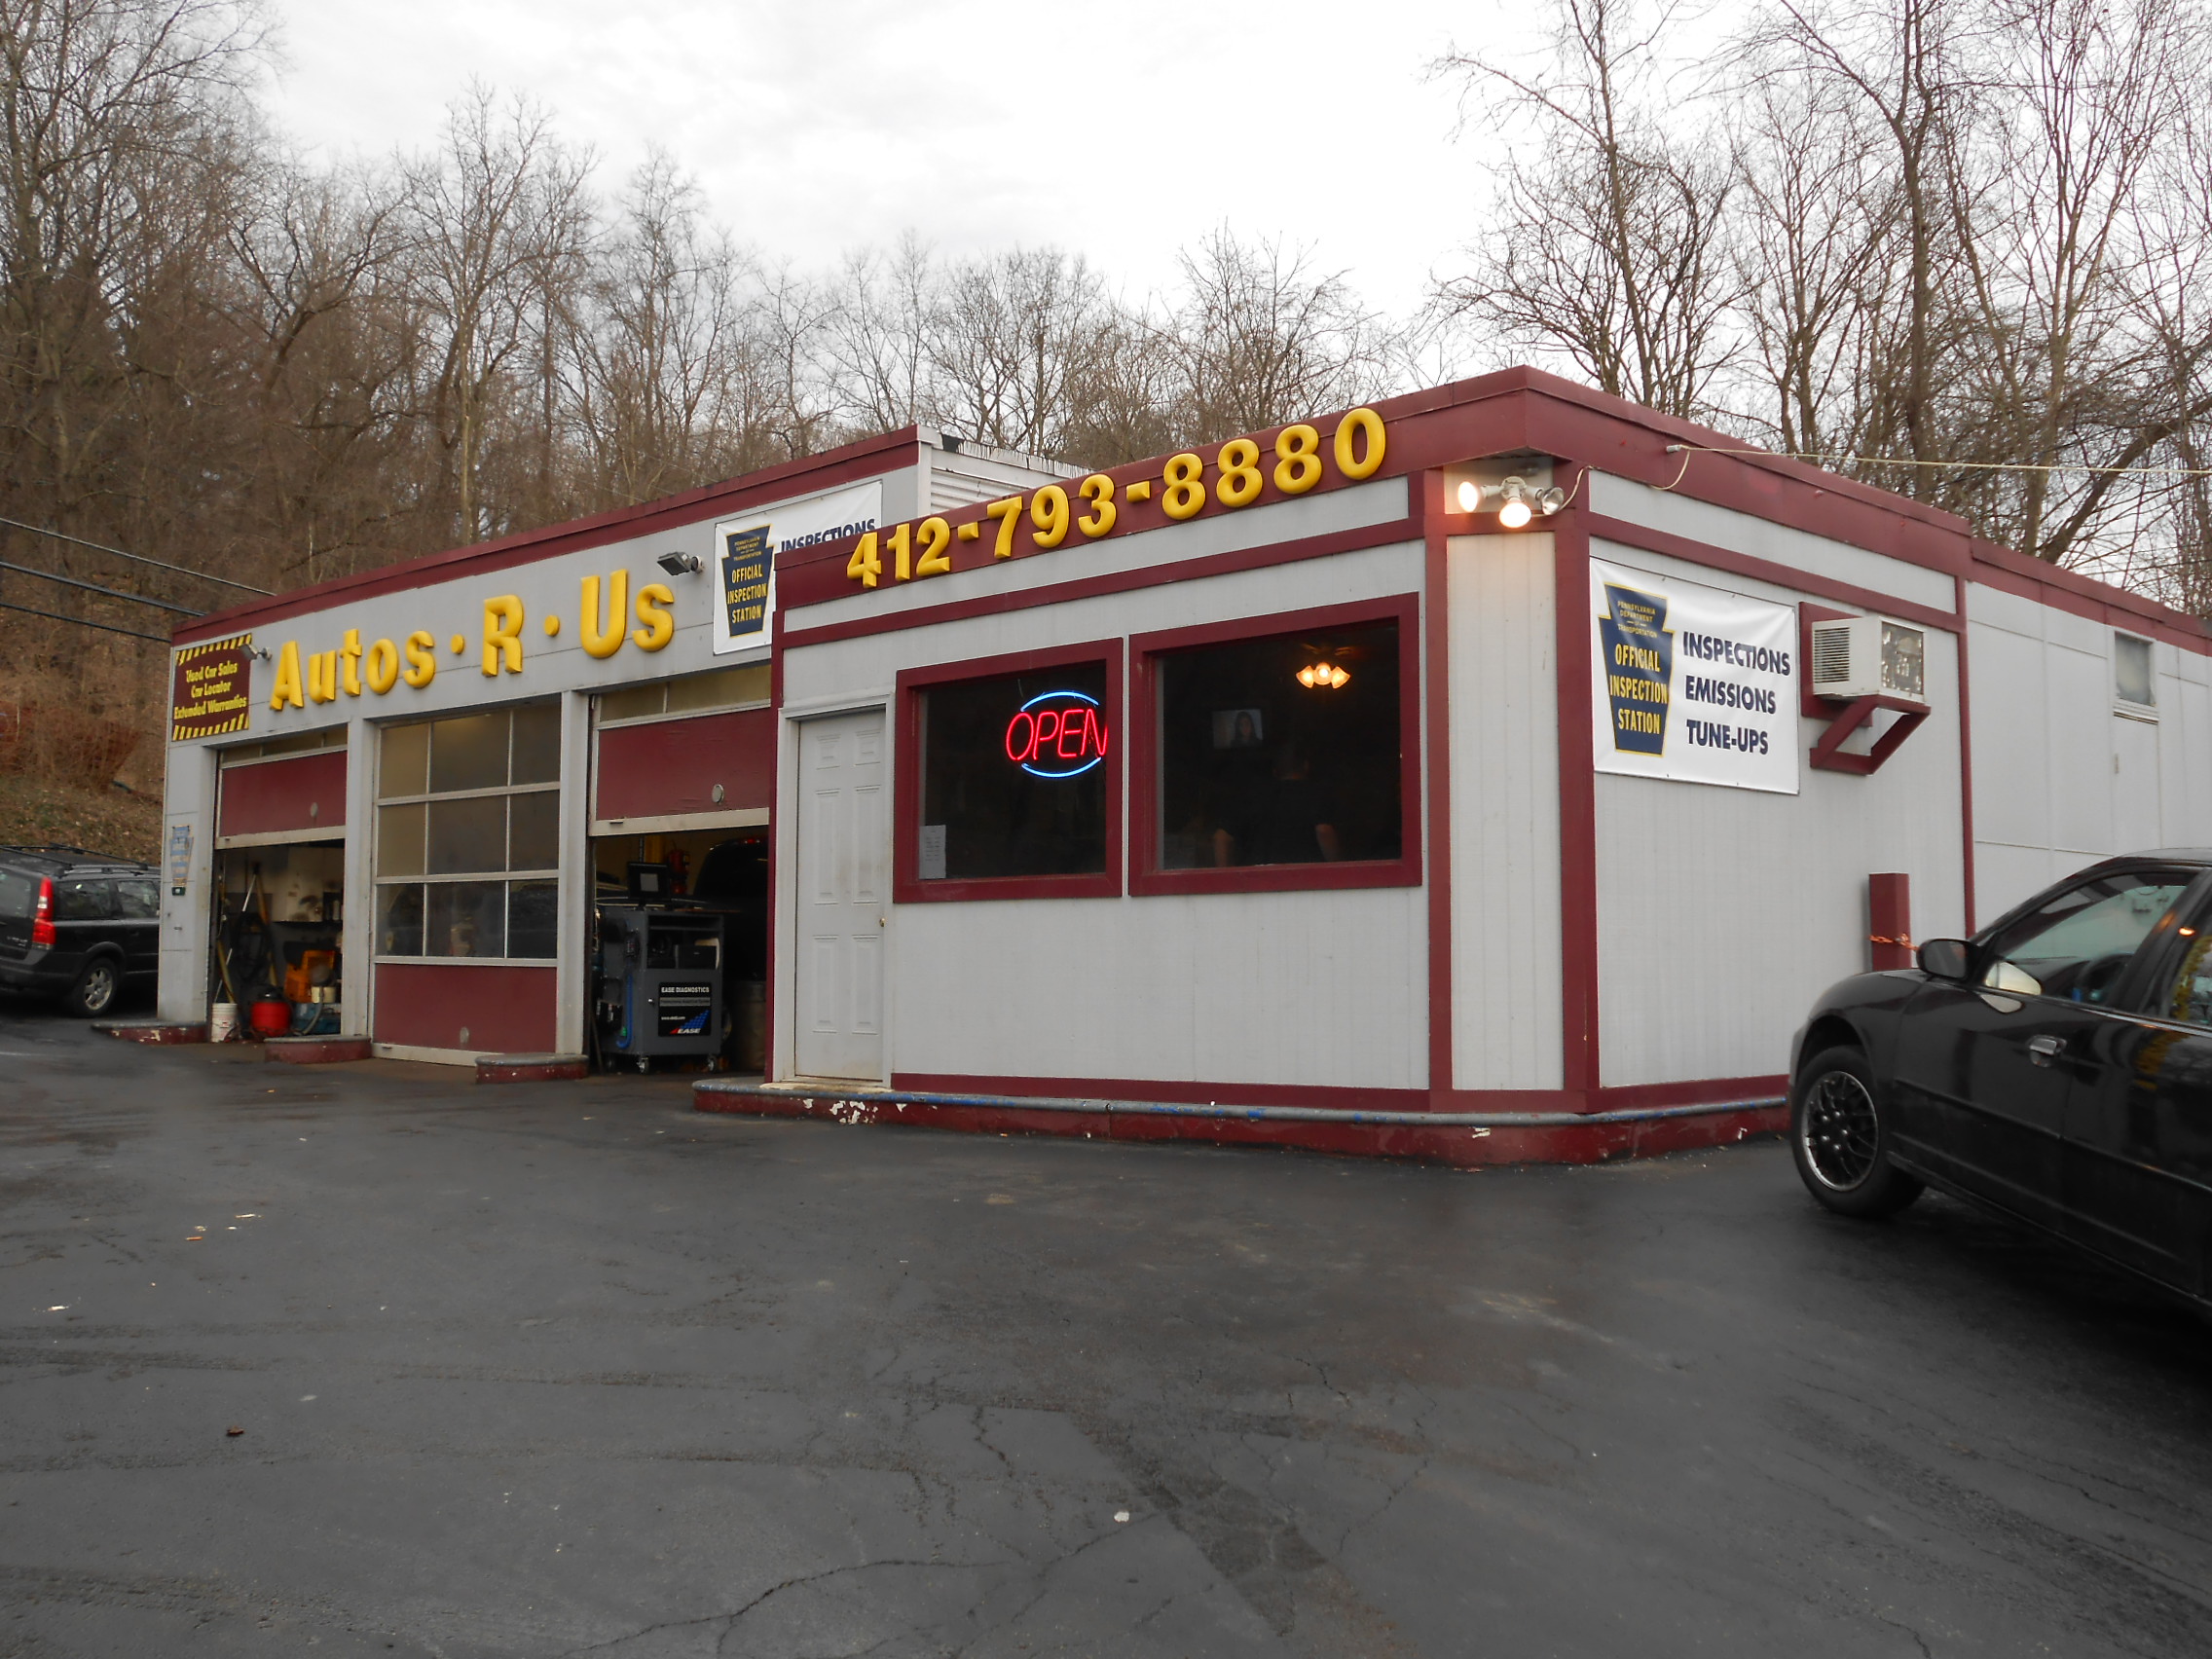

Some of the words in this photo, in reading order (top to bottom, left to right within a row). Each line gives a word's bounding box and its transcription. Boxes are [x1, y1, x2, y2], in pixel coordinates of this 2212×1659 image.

[847, 407, 1386, 588] 412-793-8880
[732, 564, 763, 584] OFFICIAL
[727, 583, 767, 606] INSPECTION
[1617, 600, 1656, 615] PENNSYLVANIA
[732, 605, 762, 624] STATION
[1619, 609, 1654, 622] DEPARTMENT
[270, 628, 436, 712] Autos
[481, 594, 524, 678] R
[580, 569, 675, 659] Us
[1683, 631, 1791, 676] INSPECTIONS
[1615, 643, 1661, 672] OFFICIAL
[186, 666, 204, 683] Used
[204, 665, 217, 680] Car
[218, 660, 239, 677] Sales
[191, 684, 203, 698] Car
[1609, 675, 1669, 704] INSPECTION
[1685, 675, 1777, 715] EMISSIONS
[174, 700, 206, 719] Extended
[1618, 708, 1661, 735] STATION
[1006, 708, 1109, 760] OPEN
[1686, 719, 1769, 756] TUNE-UPS
